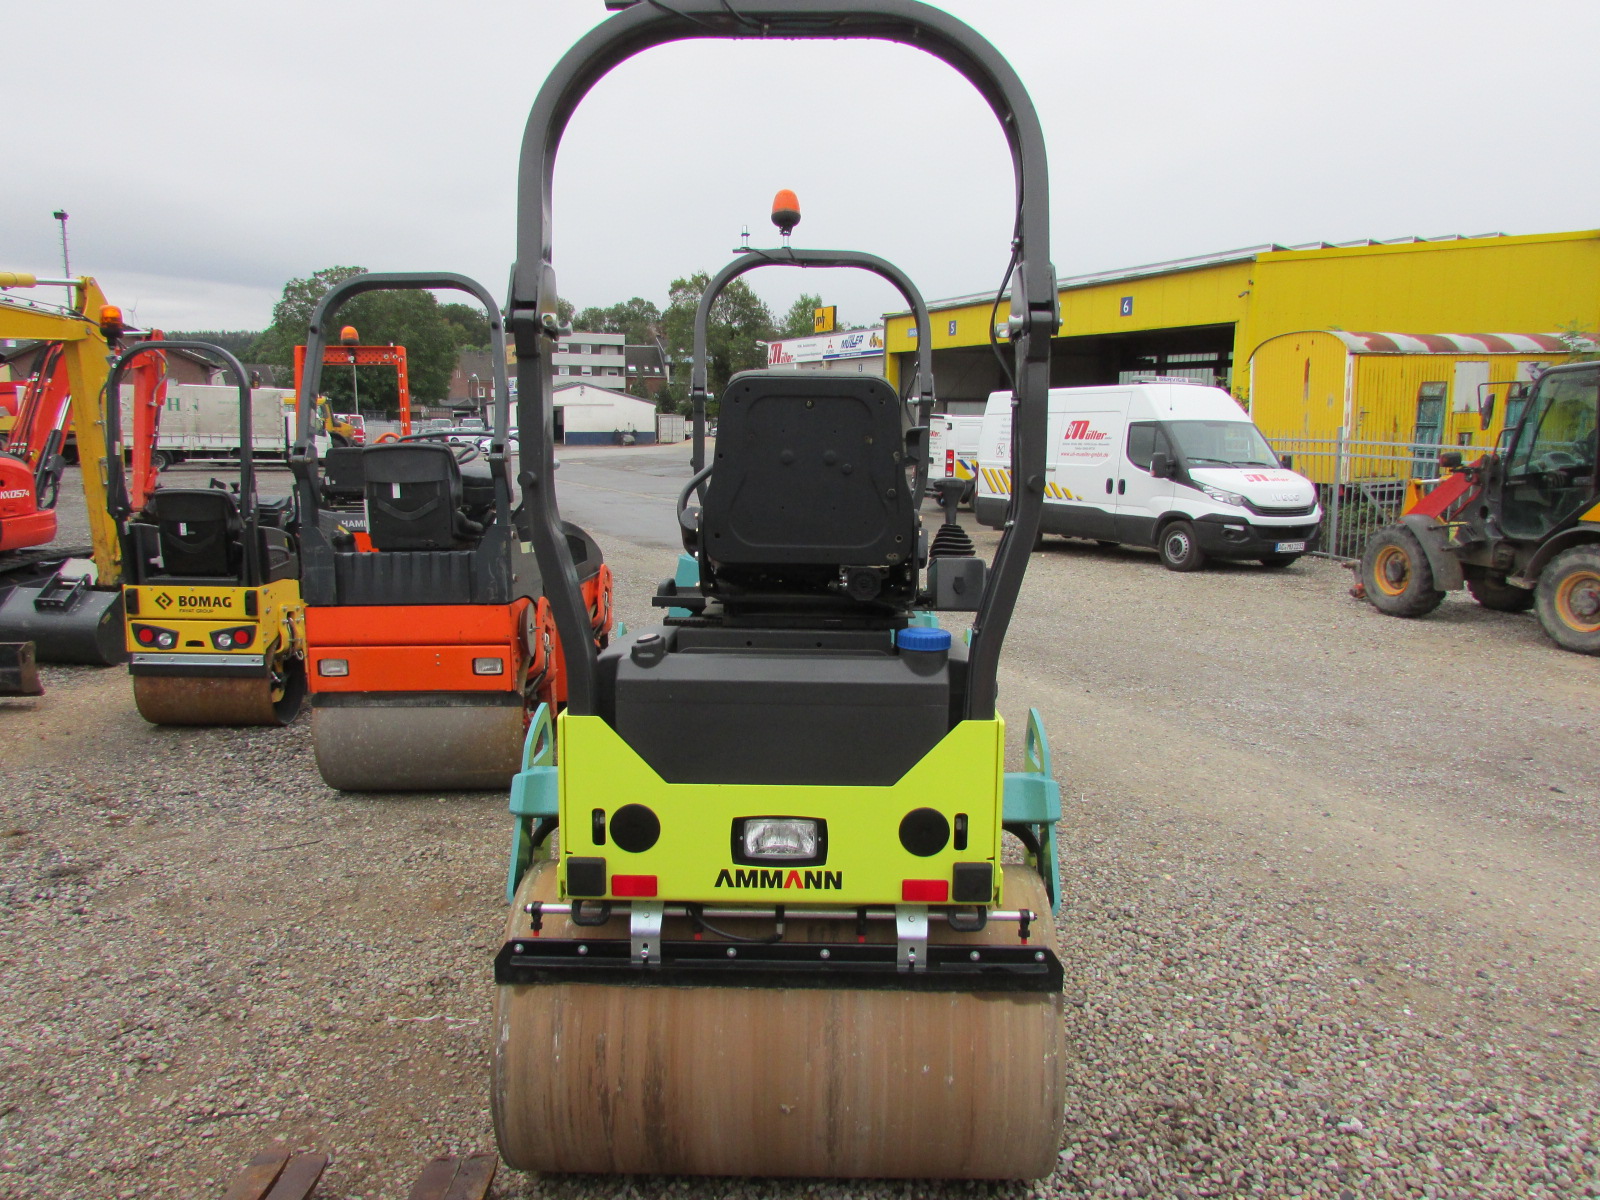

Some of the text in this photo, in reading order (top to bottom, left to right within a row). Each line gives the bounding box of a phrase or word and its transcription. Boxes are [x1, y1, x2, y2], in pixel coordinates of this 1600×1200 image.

[1123, 300, 1129, 314] 6
[950, 322, 955, 334] 5
[1064, 420, 1108, 440] Müller
[1271, 493, 1300, 502] IVECO
[178, 596, 232, 608] BOMAG
[714, 868, 843, 890] AMMANN
